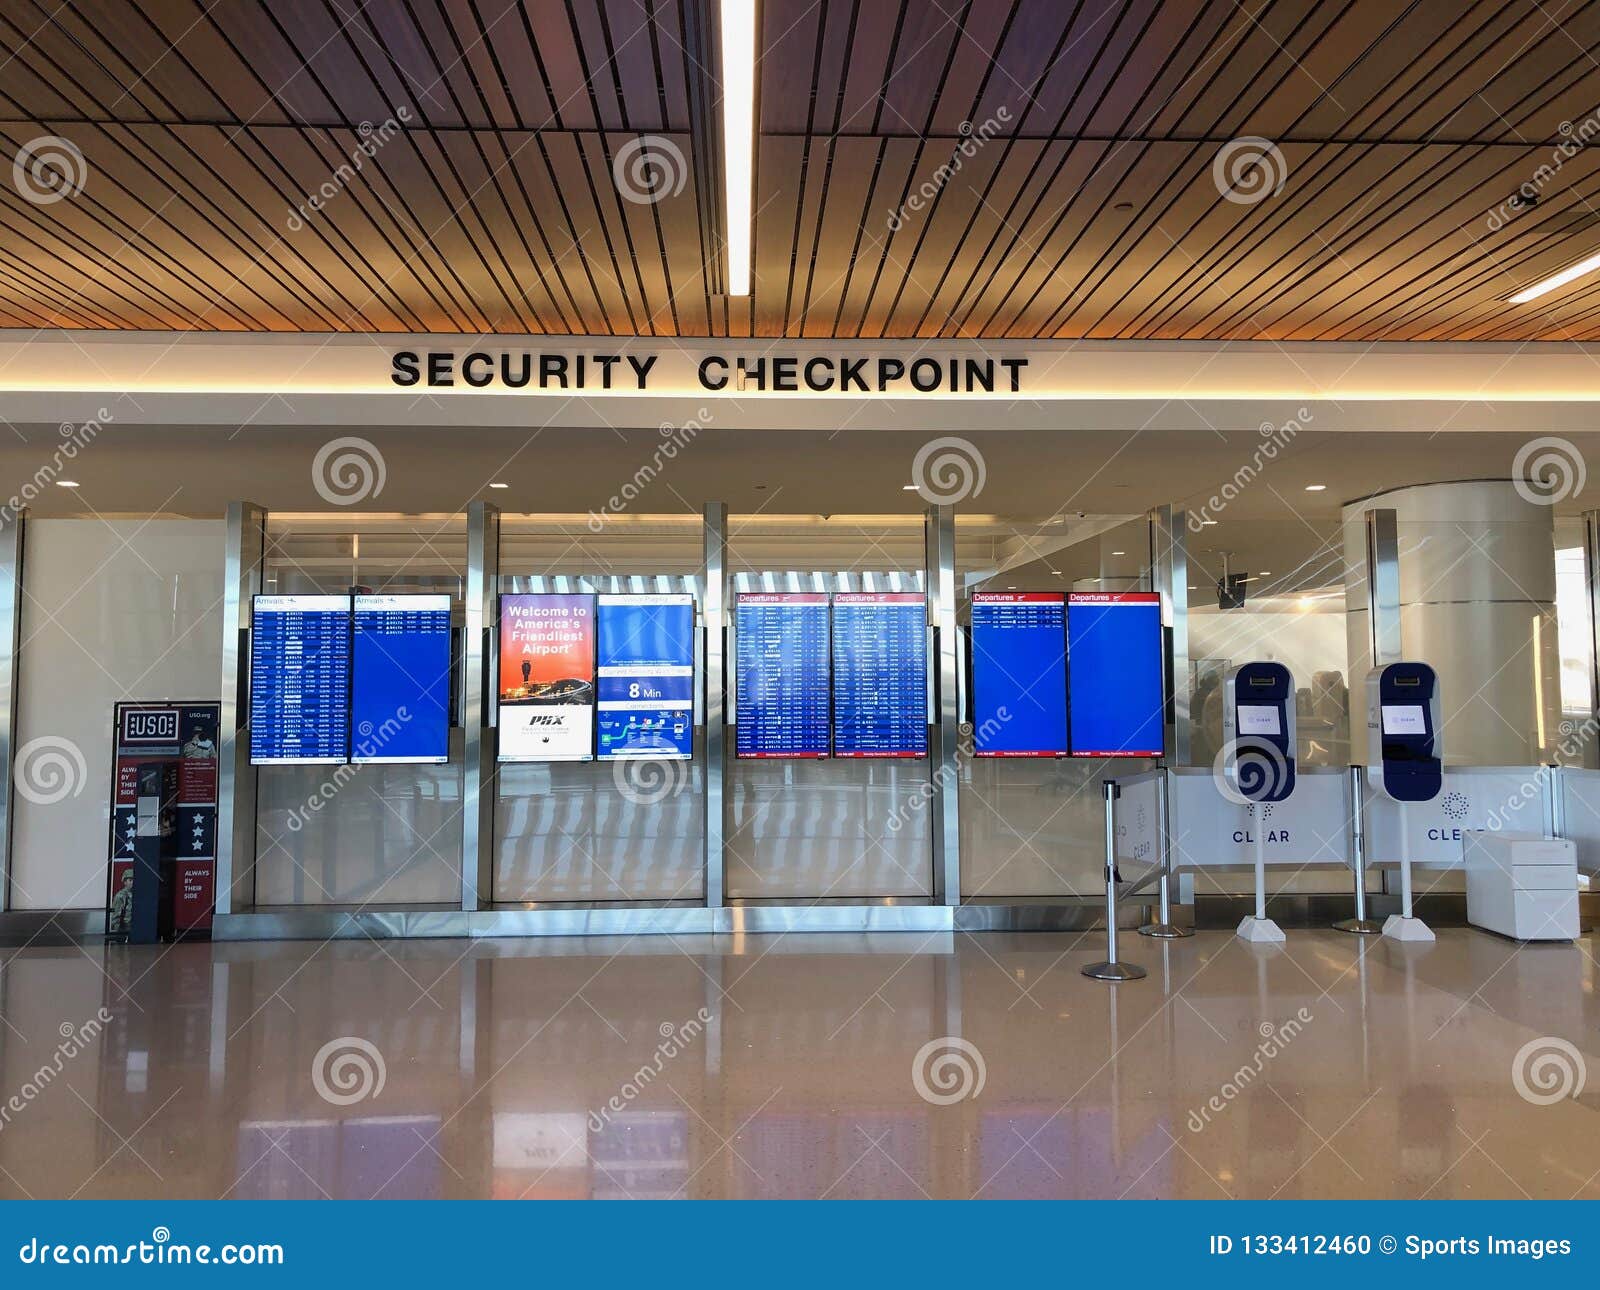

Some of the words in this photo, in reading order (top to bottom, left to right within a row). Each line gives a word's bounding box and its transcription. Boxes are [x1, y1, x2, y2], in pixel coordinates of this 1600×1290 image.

[390, 351, 659, 390] SECURITY
[698, 355, 1029, 392] CHECKPOINT
[836, 594, 875, 602] Departures
[974, 594, 1014, 602] Departures
[1070, 594, 1109, 602] Departures
[508, 606, 569, 617] Welcome
[573, 606, 587, 617] to
[514, 619, 581, 629] America's
[512, 631, 584, 641] Friendliest
[629, 683, 640, 698] 8
[643, 688, 662, 698] Min
[136, 715, 168, 735] USO
[1232, 830, 1290, 843] CLAR
[1428, 829, 1485, 841] CLE
